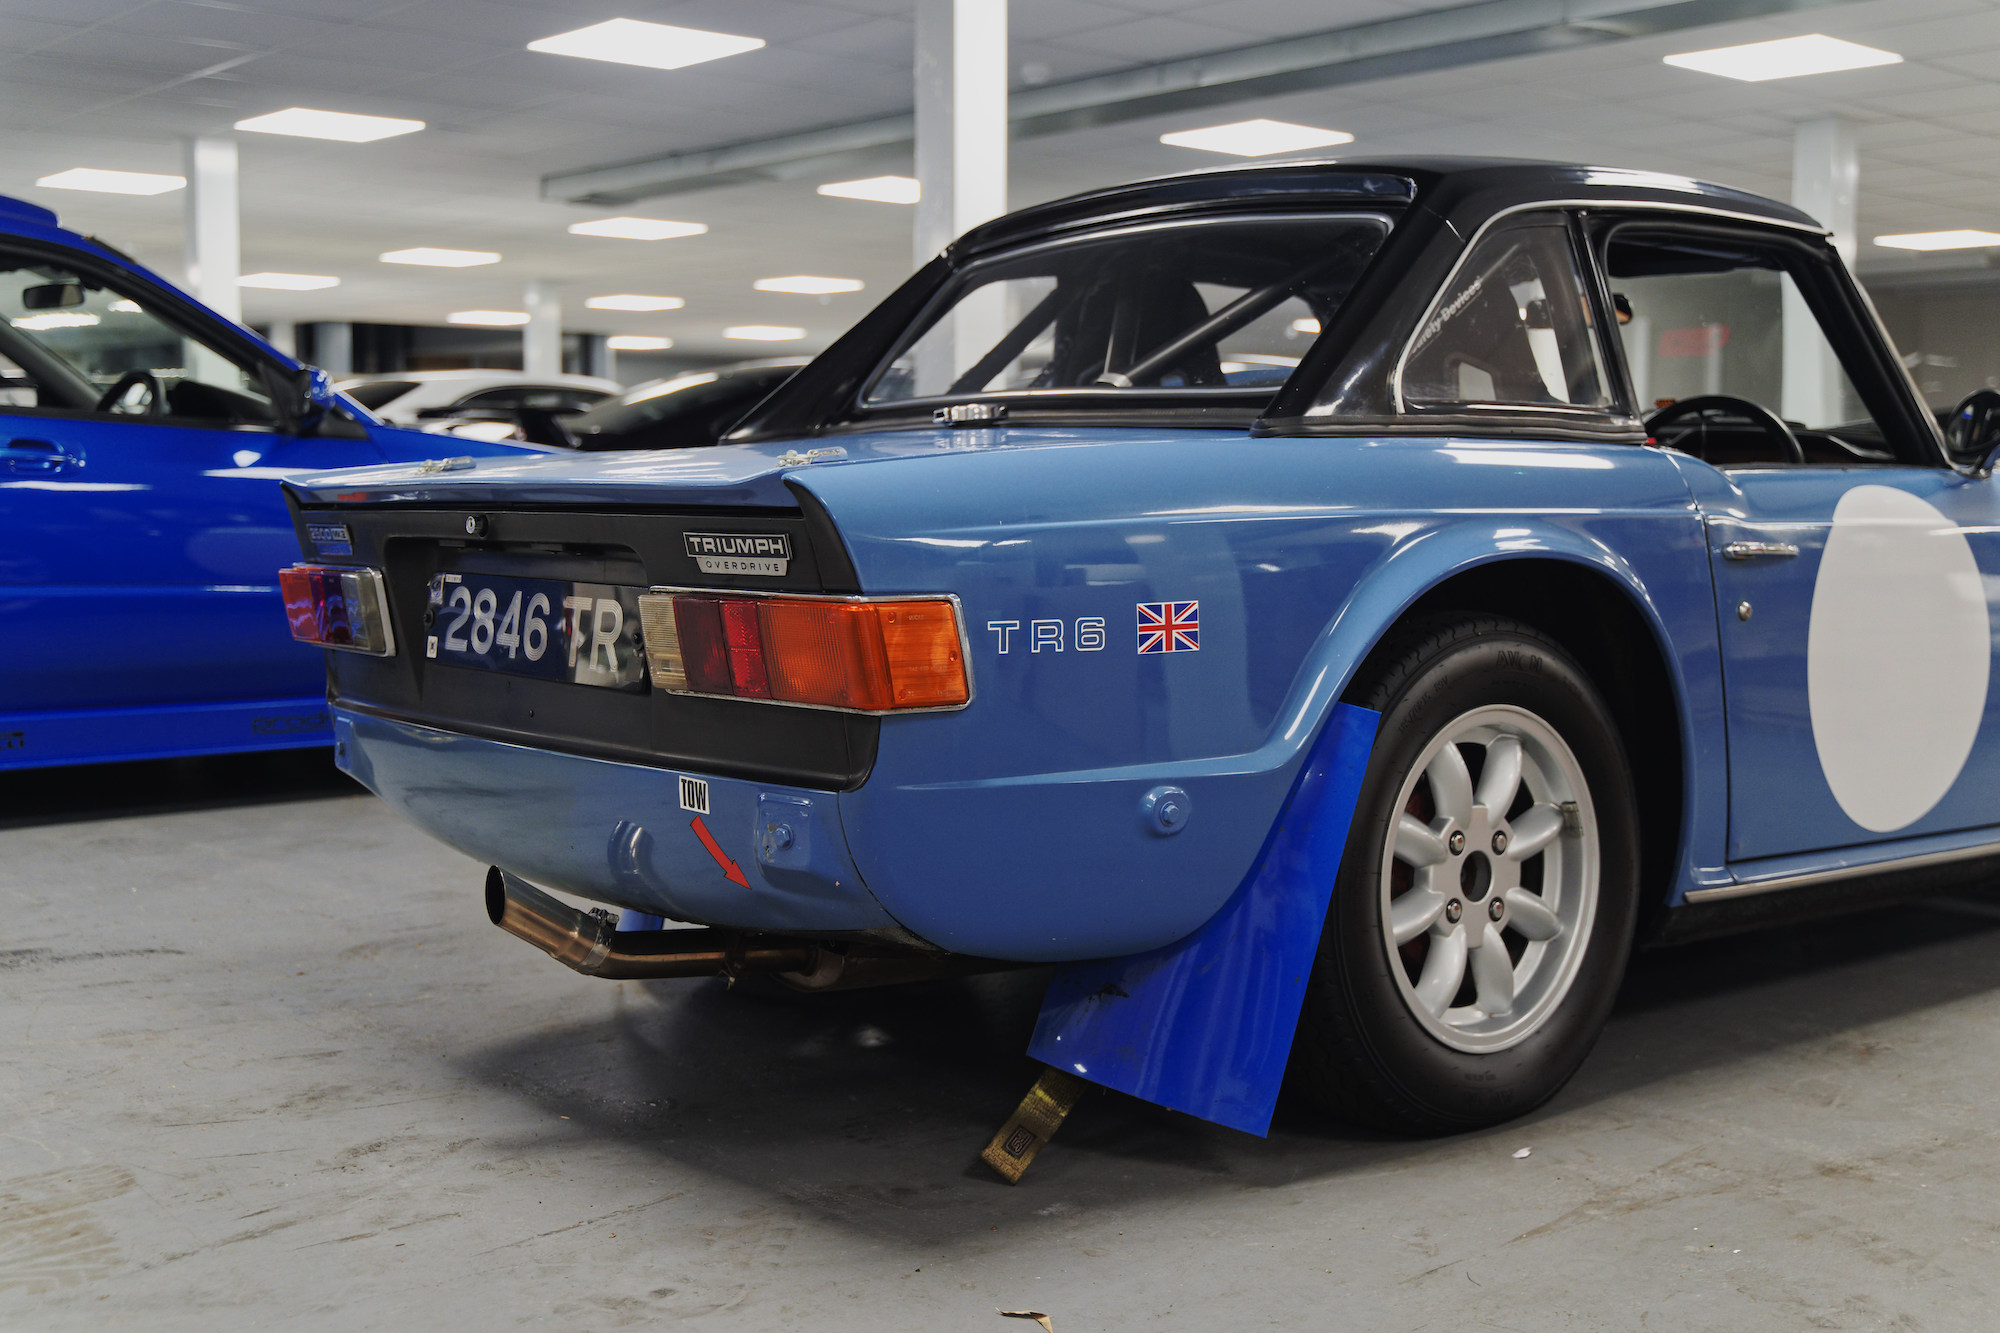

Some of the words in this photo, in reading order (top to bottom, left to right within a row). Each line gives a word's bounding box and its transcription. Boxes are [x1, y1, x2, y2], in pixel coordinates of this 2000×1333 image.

[1440, 279, 1482, 322] Devices
[689, 537, 784, 555] TRIUMPH
[705, 560, 780, 572] OVERDRIVE
[445, 586, 550, 662] 2846
[563, 596, 624, 673] TR
[987, 616, 1106, 655] TR6
[681, 778, 707, 811] TOW
